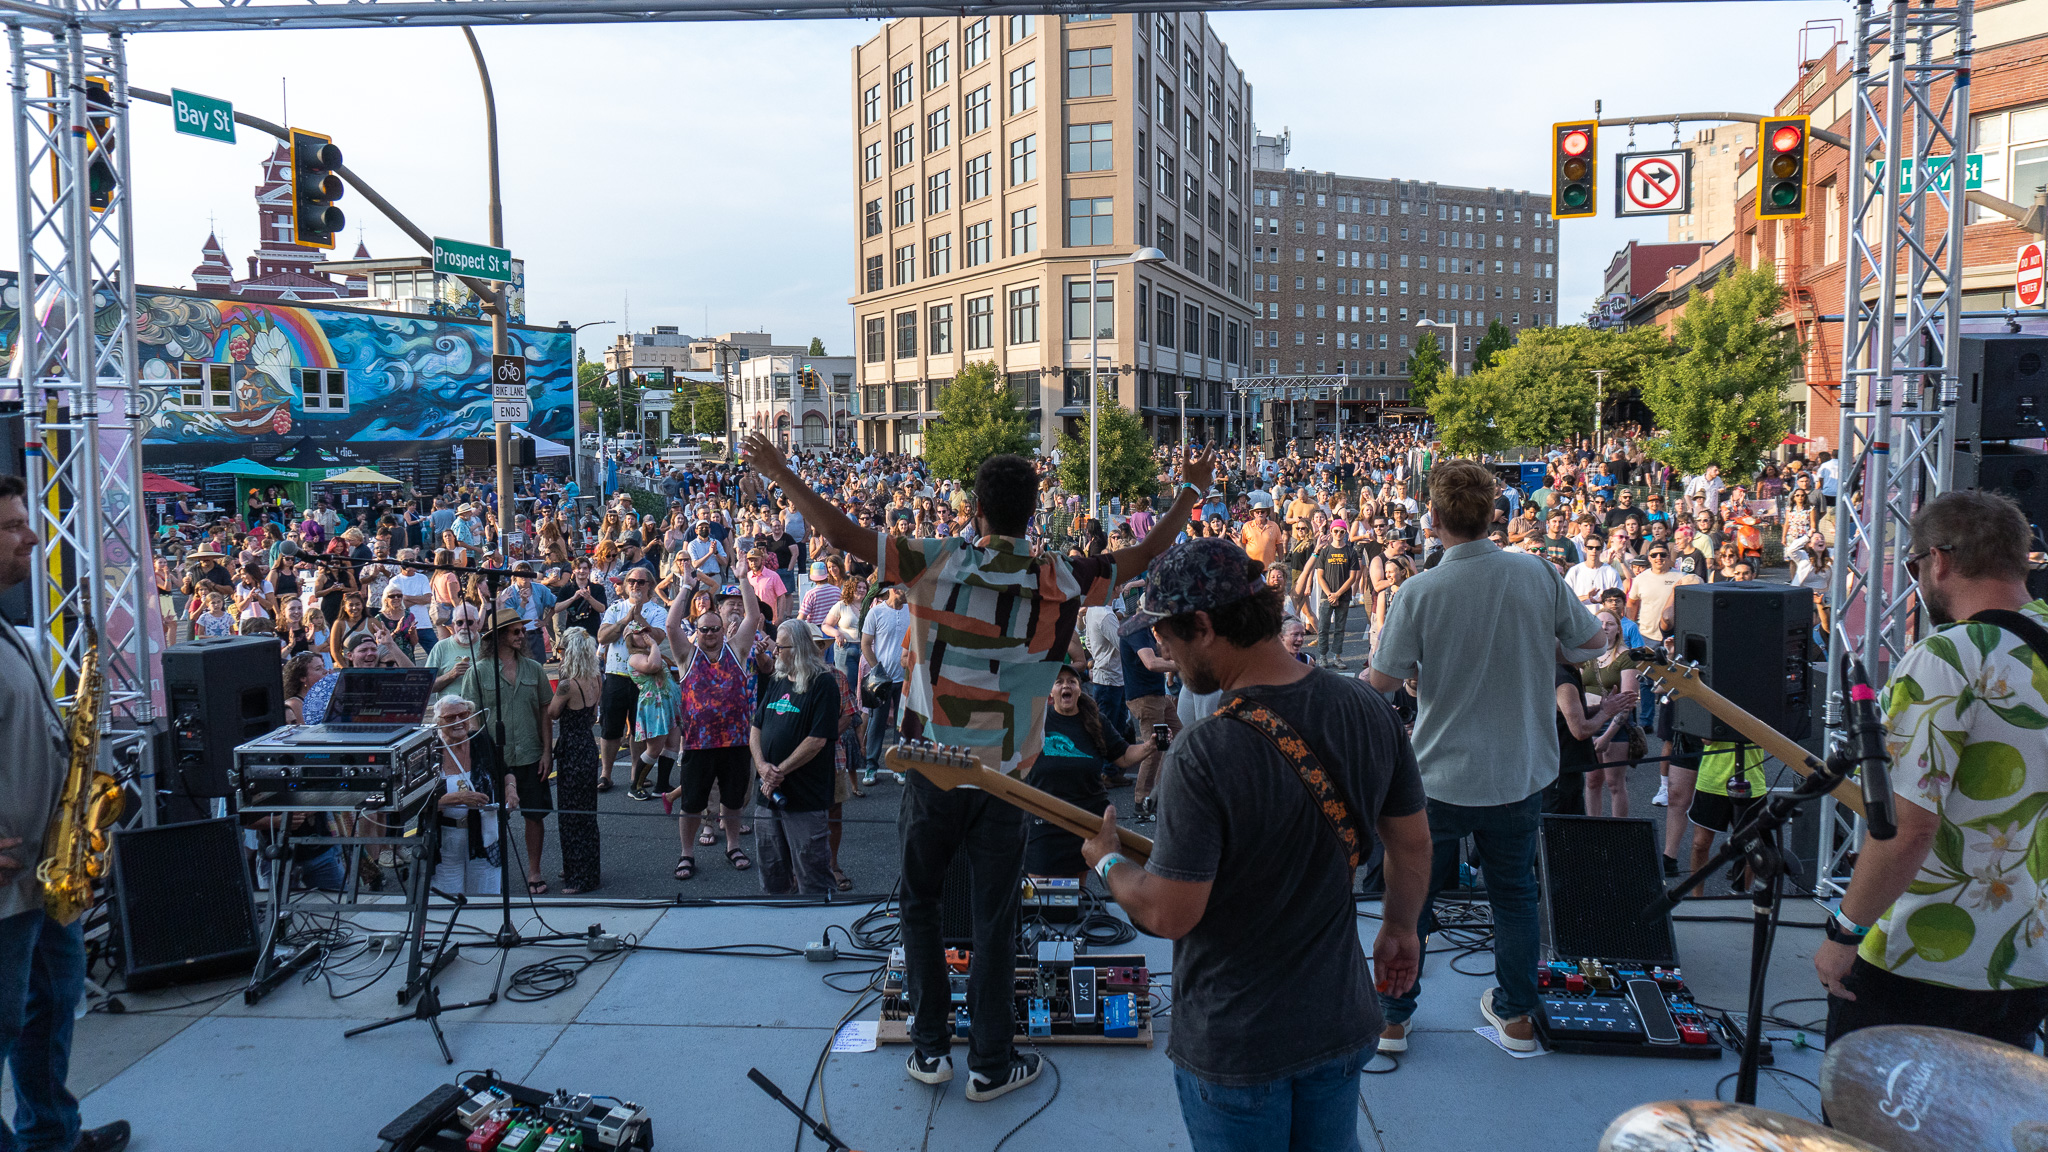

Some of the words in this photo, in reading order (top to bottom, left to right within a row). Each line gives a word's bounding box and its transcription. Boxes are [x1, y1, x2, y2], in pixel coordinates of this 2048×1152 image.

[177, 100, 209, 132] Bay
[213, 109, 231, 133] St
[435, 246, 485, 271] Prospect
[488, 255, 500, 272] St
[2020, 257, 2029, 268] DO
[2030, 254, 2041, 266] NOT
[2021, 282, 2038, 295] ENTER
[495, 386, 508, 396] BIKE
[510, 386, 524, 396] LANE
[500, 406, 521, 417] ENDS
[1078, 982, 1090, 1001] VOX
